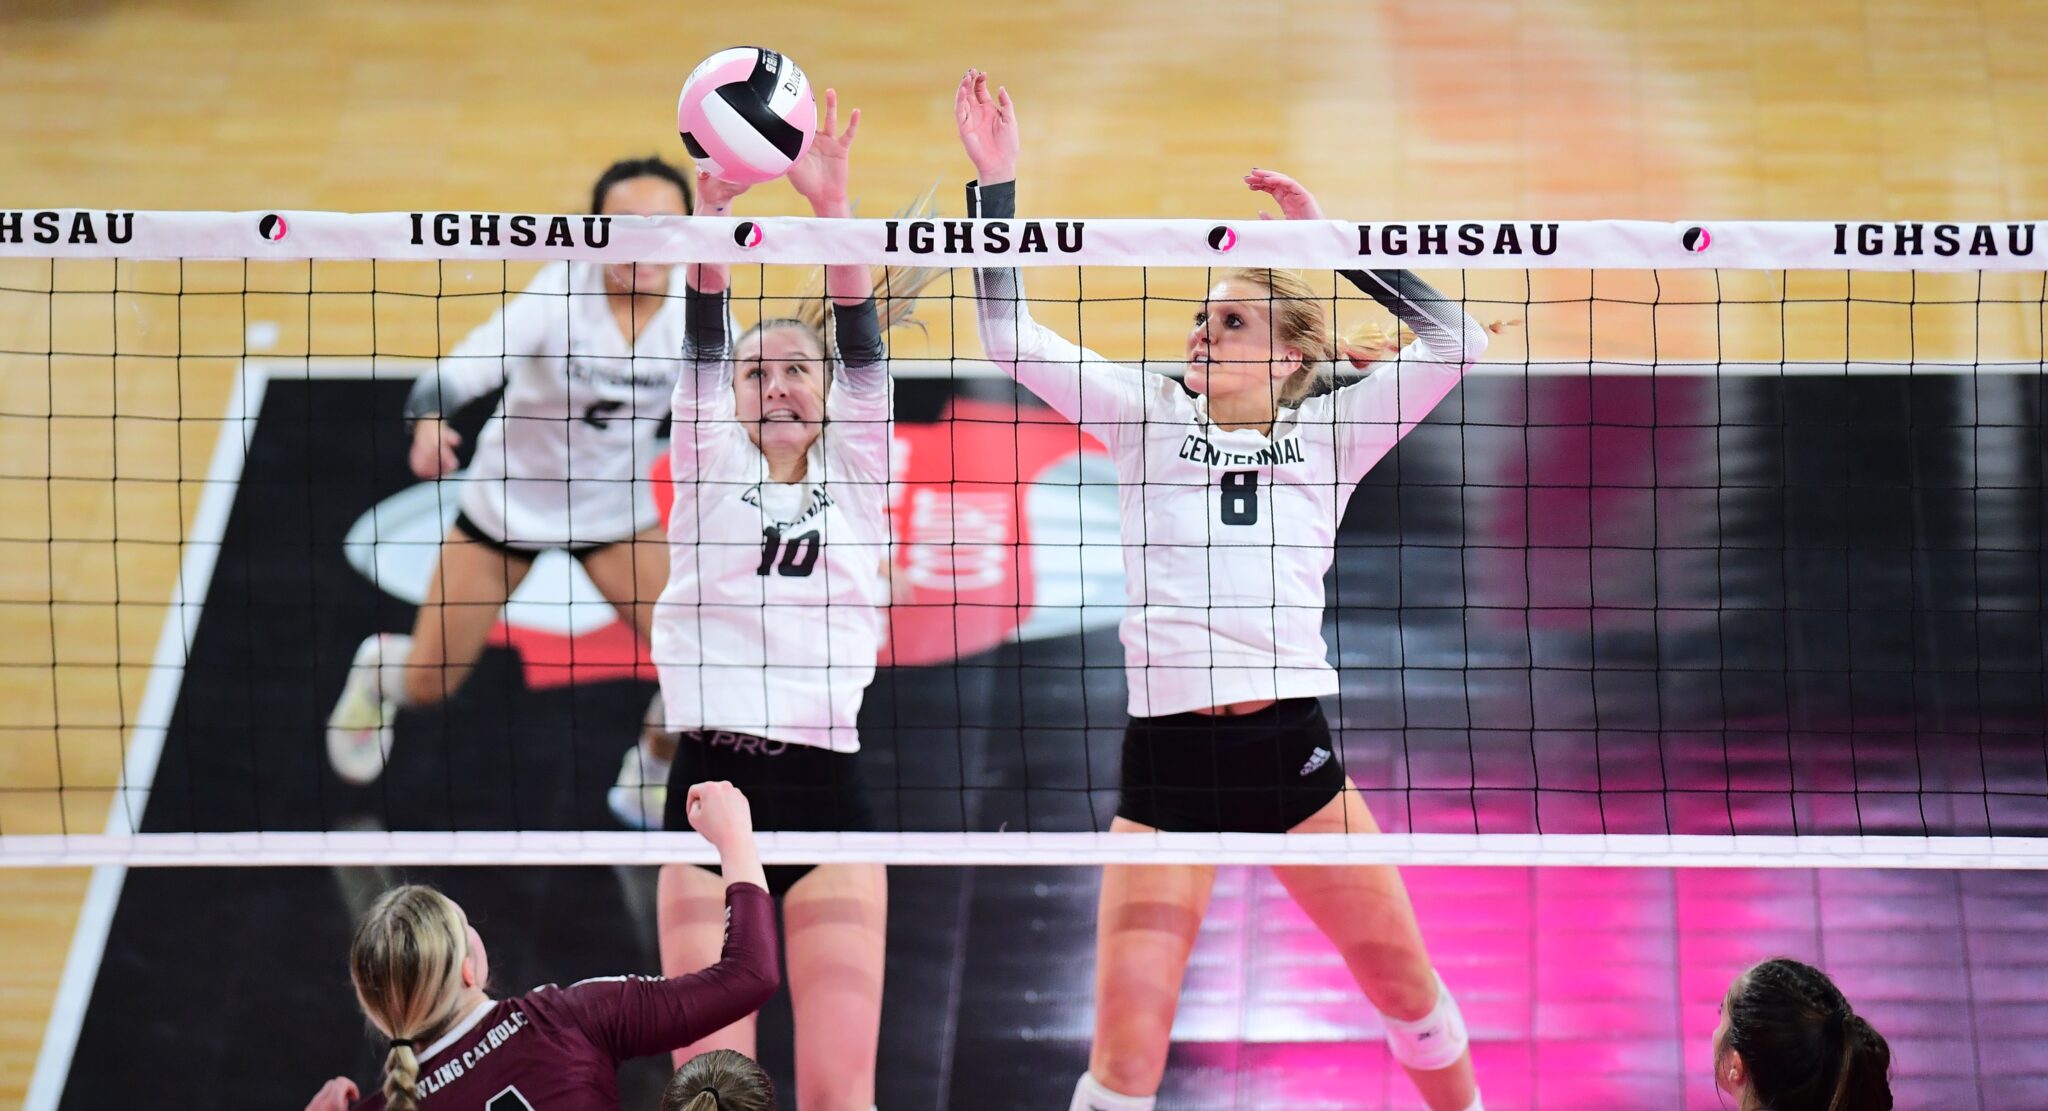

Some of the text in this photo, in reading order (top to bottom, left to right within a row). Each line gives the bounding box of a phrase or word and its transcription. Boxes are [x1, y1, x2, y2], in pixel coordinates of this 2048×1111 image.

[0, 211, 134, 244] HSAU
[410, 213, 612, 248] IGHSAU
[885, 221, 1085, 254] IGHSAU
[1358, 223, 1559, 256] IGHSAU
[1834, 223, 2036, 256] IGHSAU
[1179, 434, 1305, 466] CENTENNIAL
[1220, 470, 1258, 526] 8
[757, 526, 820, 577] 10
[711, 731, 787, 756] PRO
